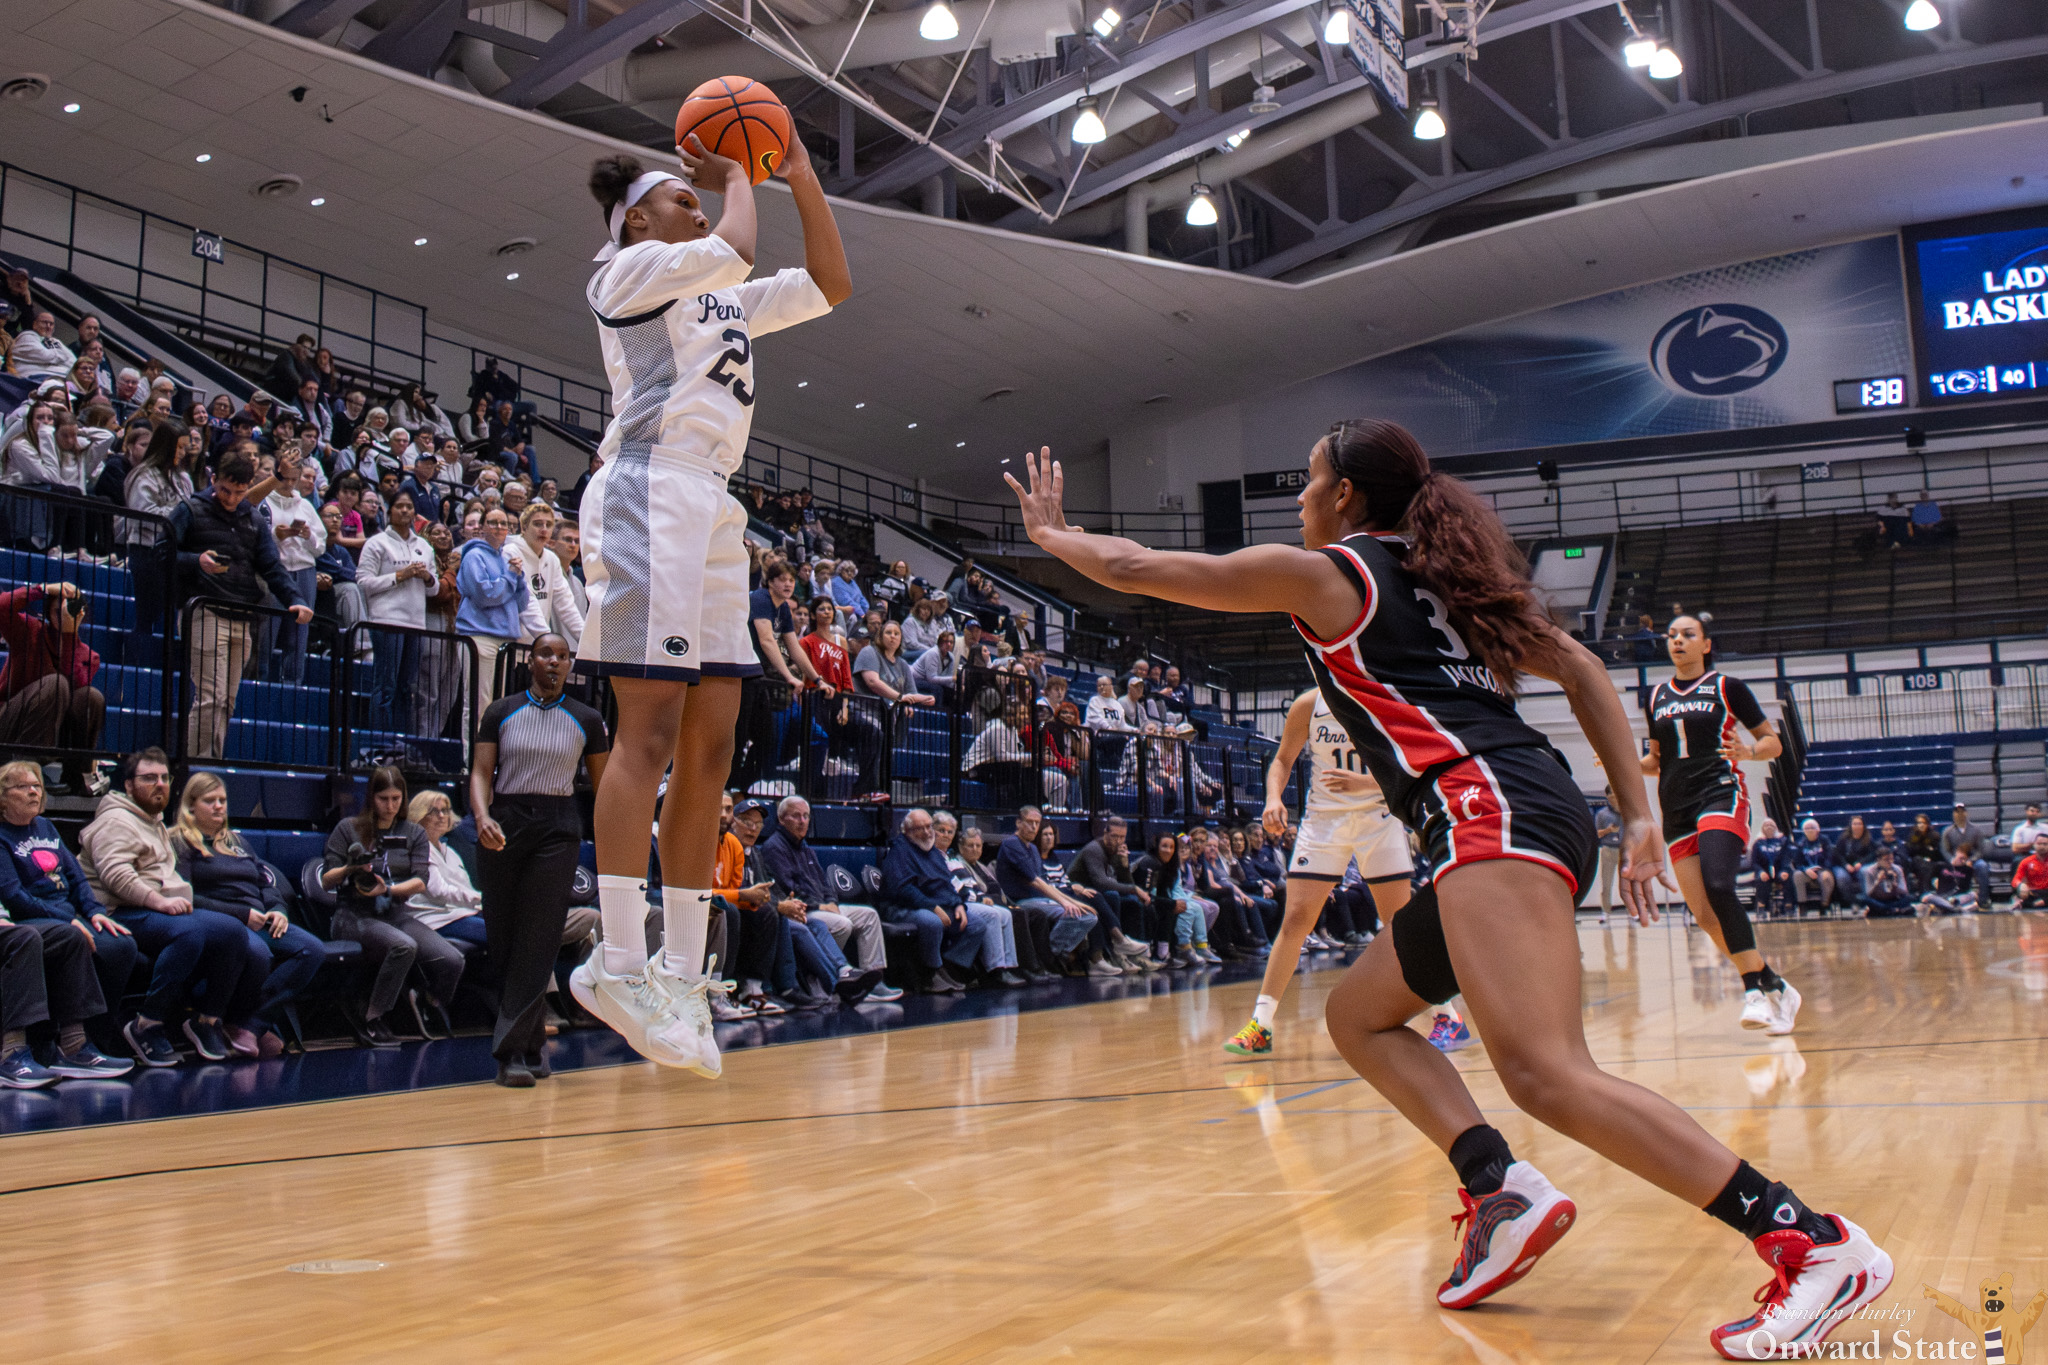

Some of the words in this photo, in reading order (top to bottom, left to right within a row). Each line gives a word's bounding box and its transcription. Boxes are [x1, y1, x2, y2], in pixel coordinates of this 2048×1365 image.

[195, 236, 221, 260] 204
[698, 293, 746, 324] Penn
[2001, 368, 2026, 386] 40
[1861, 378, 1903, 406] 1:38
[1804, 465, 1830, 480] 208
[1413, 587, 1470, 660] 3
[1906, 674, 1938, 689] 108
[1316, 726, 1347, 744] Penn
[1673, 718, 1690, 759] 1
